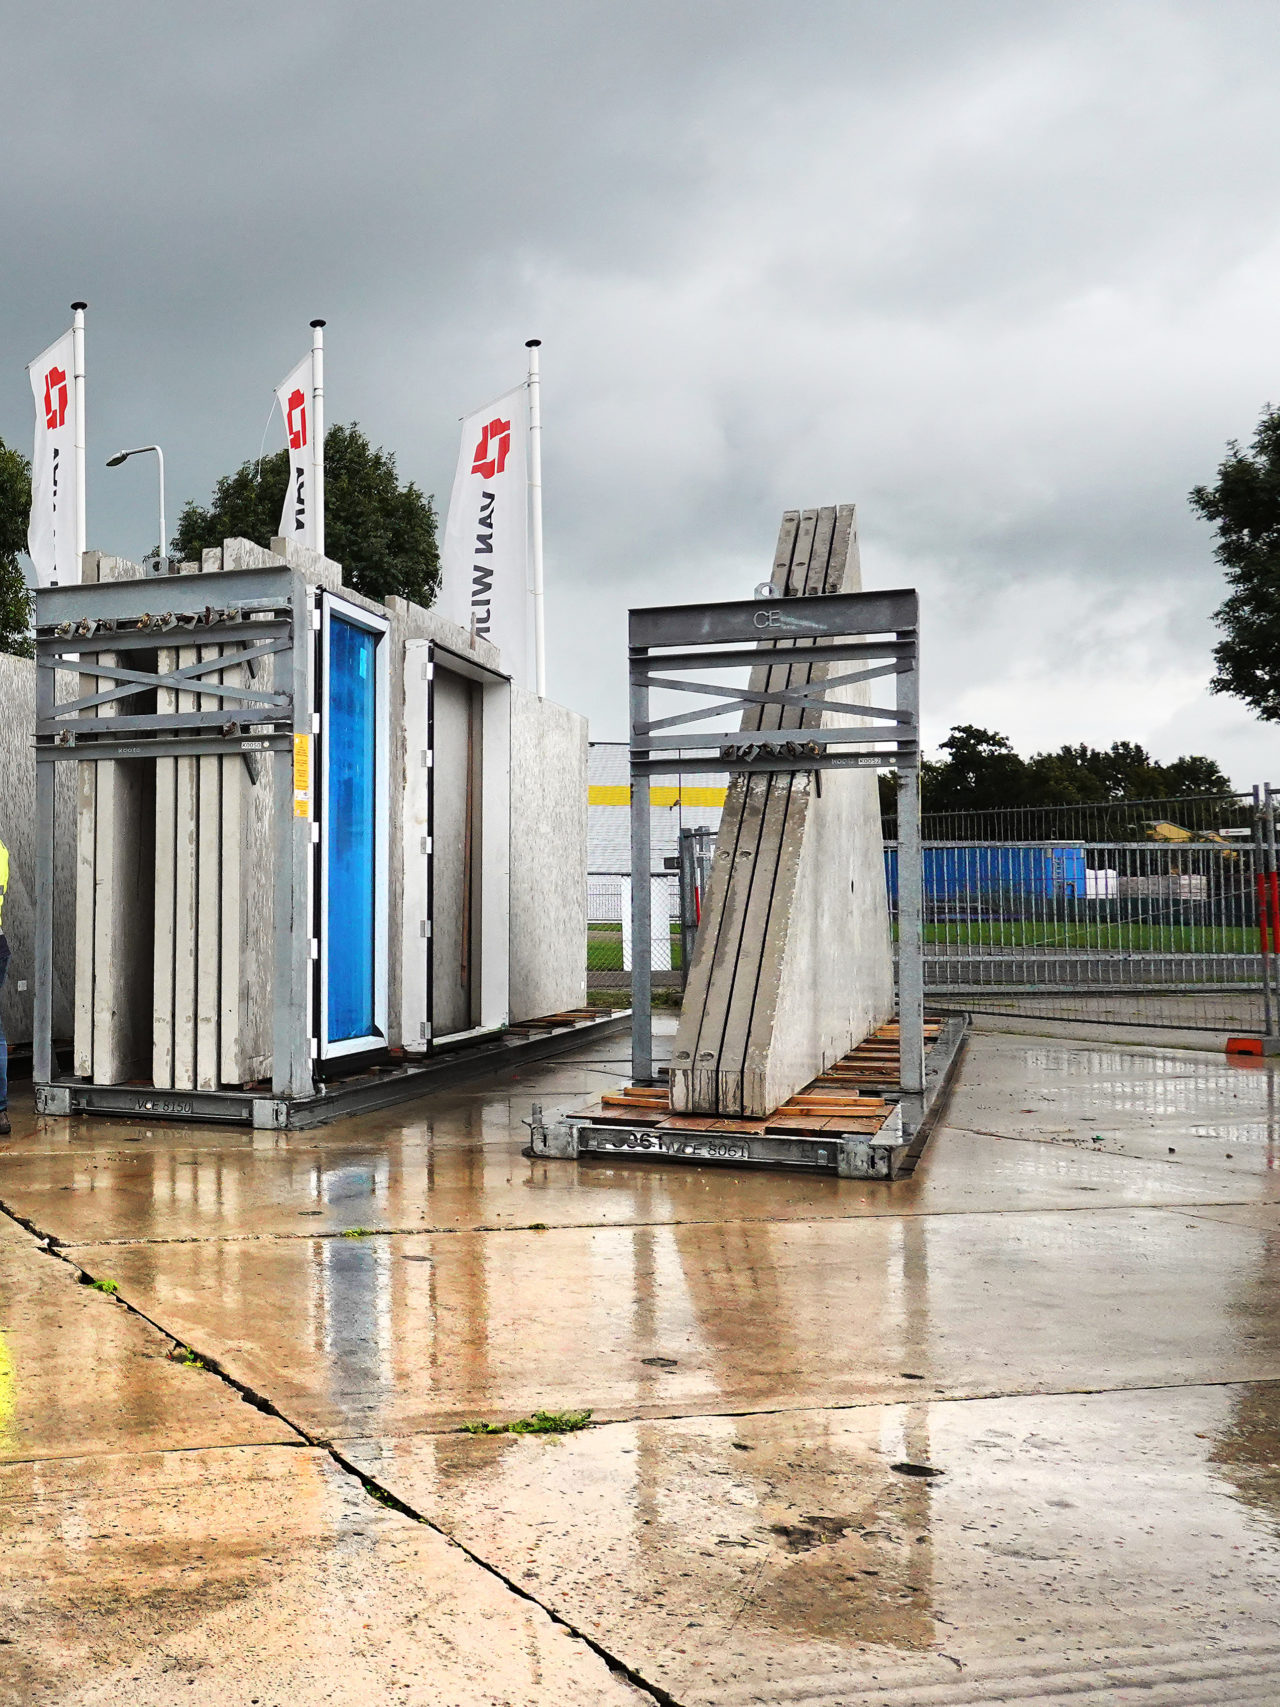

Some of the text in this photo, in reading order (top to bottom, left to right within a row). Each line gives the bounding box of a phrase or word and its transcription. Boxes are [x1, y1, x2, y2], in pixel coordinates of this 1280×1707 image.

[754, 610, 780, 628] CE
[163, 1100, 191, 1113] 8150
[708, 1141, 745, 1158] 8061
